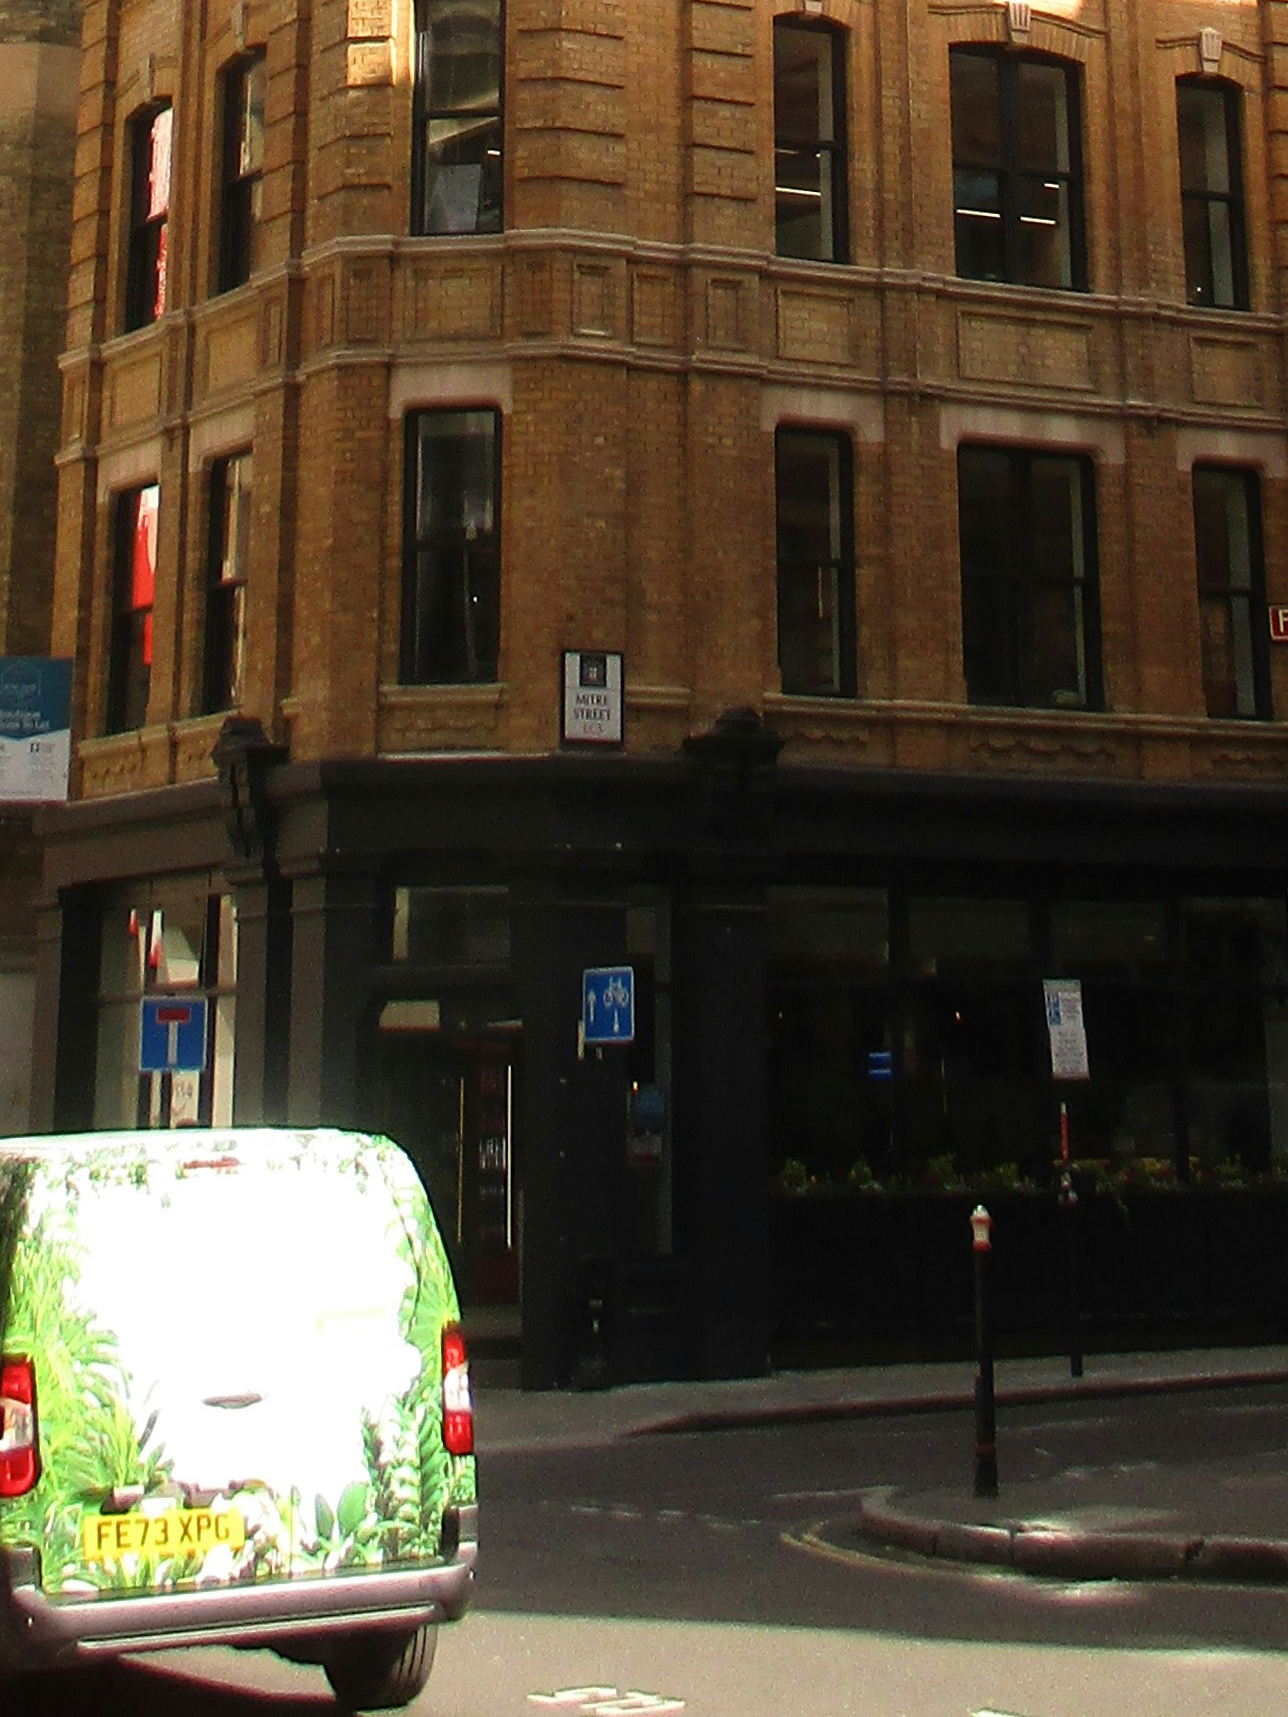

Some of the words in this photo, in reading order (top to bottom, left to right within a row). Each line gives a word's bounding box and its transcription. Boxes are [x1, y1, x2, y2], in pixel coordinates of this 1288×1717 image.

[576, 694, 608, 705] MITRE
[573, 708, 611, 721] STREET
[96, 1517, 169, 1550] FE73
[179, 1513, 231, 1543] XPG
